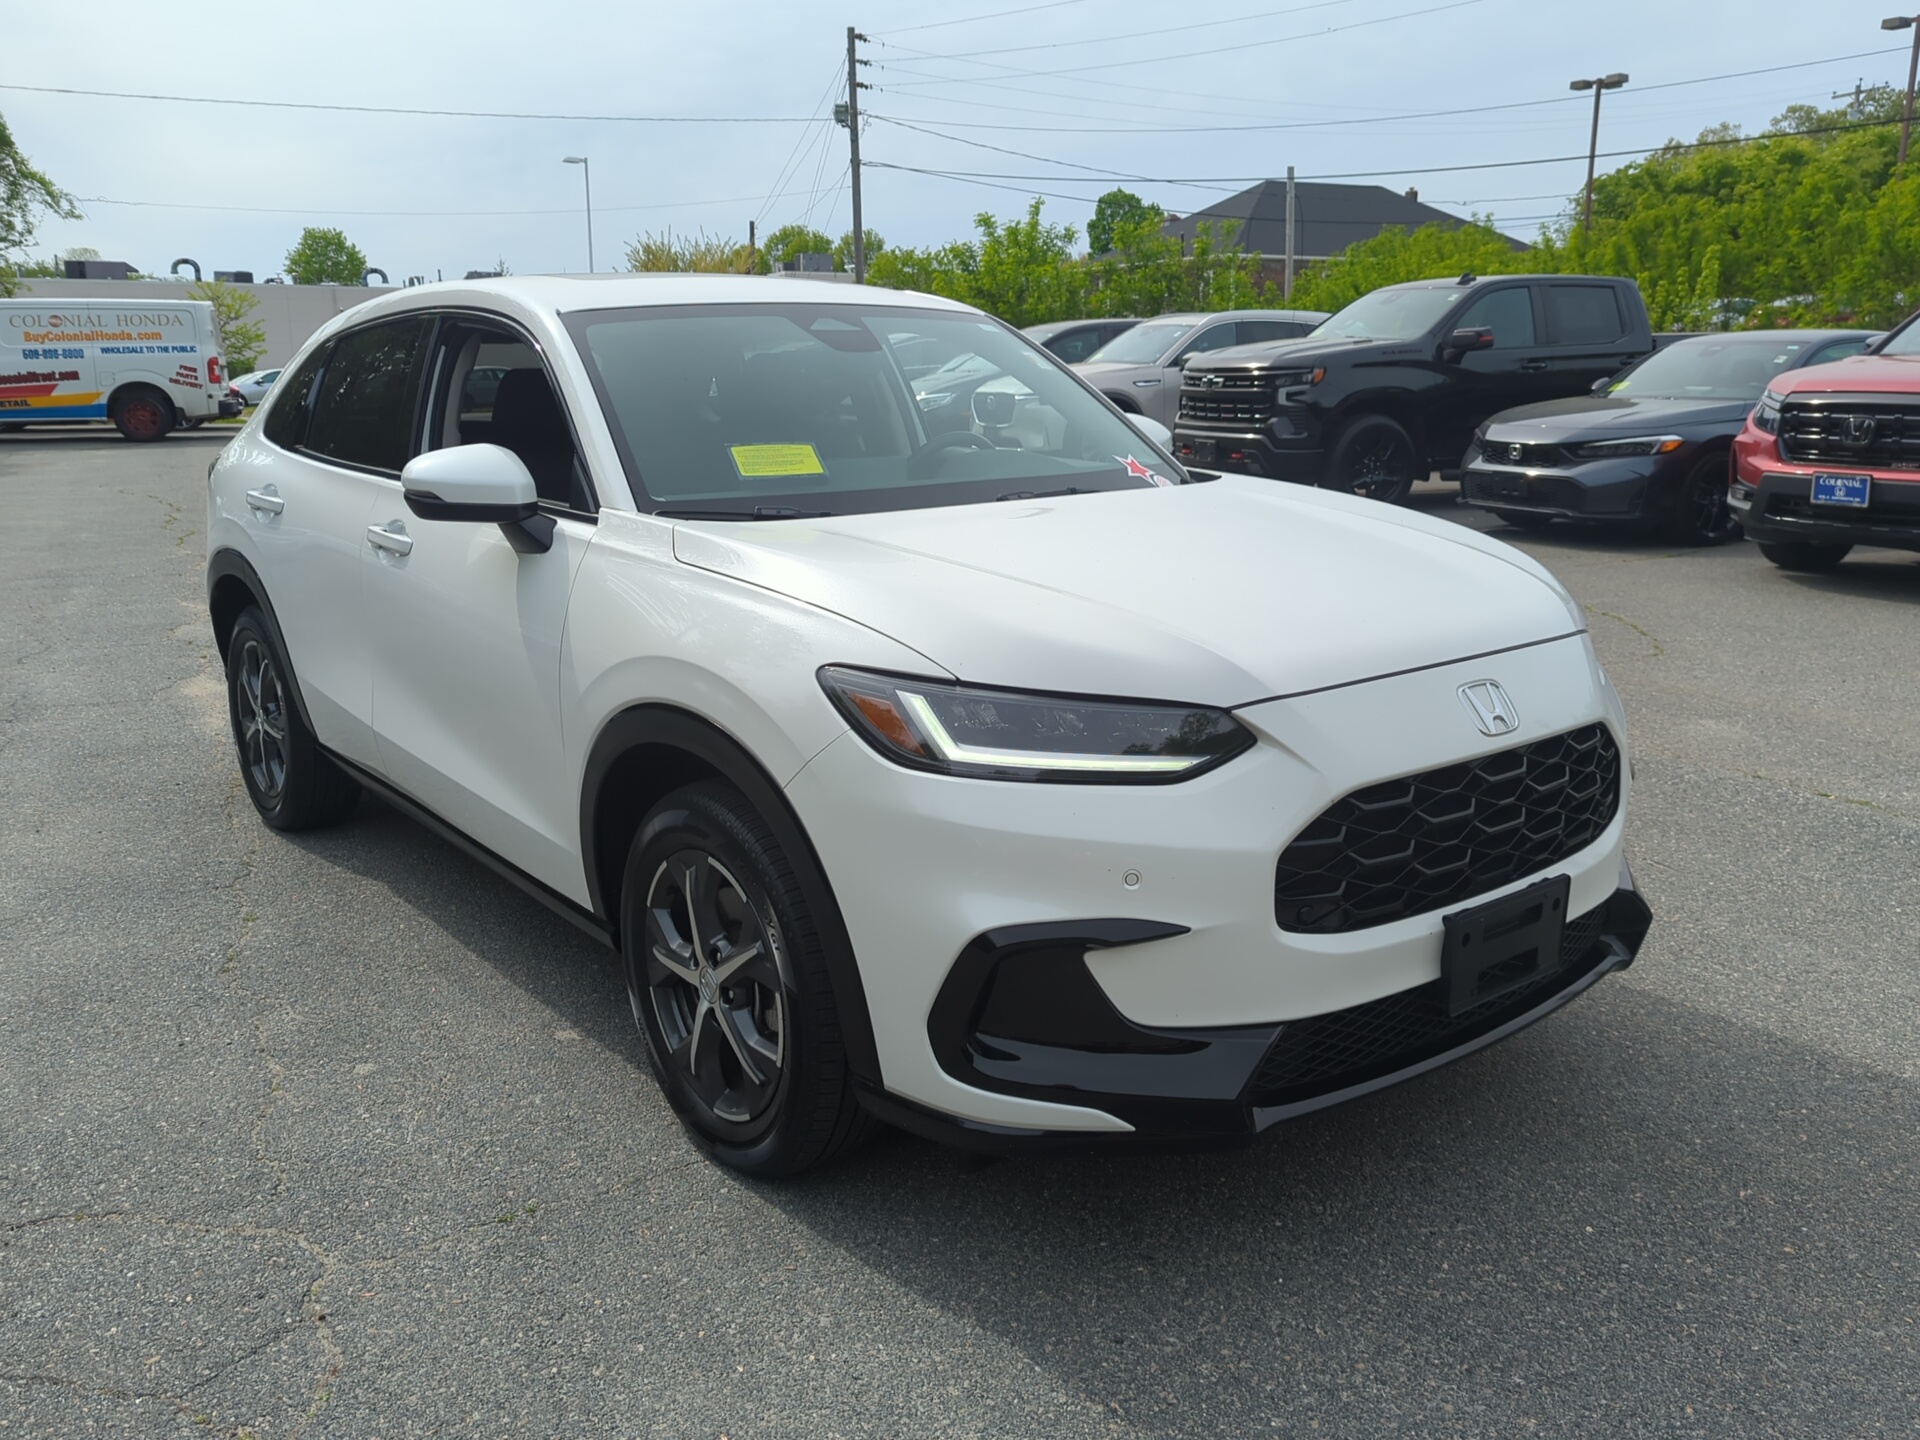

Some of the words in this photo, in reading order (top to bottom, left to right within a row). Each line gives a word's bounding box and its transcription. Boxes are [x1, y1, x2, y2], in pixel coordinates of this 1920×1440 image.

[9, 314, 108, 328] COLONIAL
[116, 313, 184, 327] HONDA
[23, 330, 162, 344] BuyColonialHonda.com
[100, 346, 144, 354] WHOLESALE
[171, 345, 197, 353] PUBLIC
[169, 378, 204, 390] DELIVERY
[1819, 477, 1863, 488] COLONIAL
